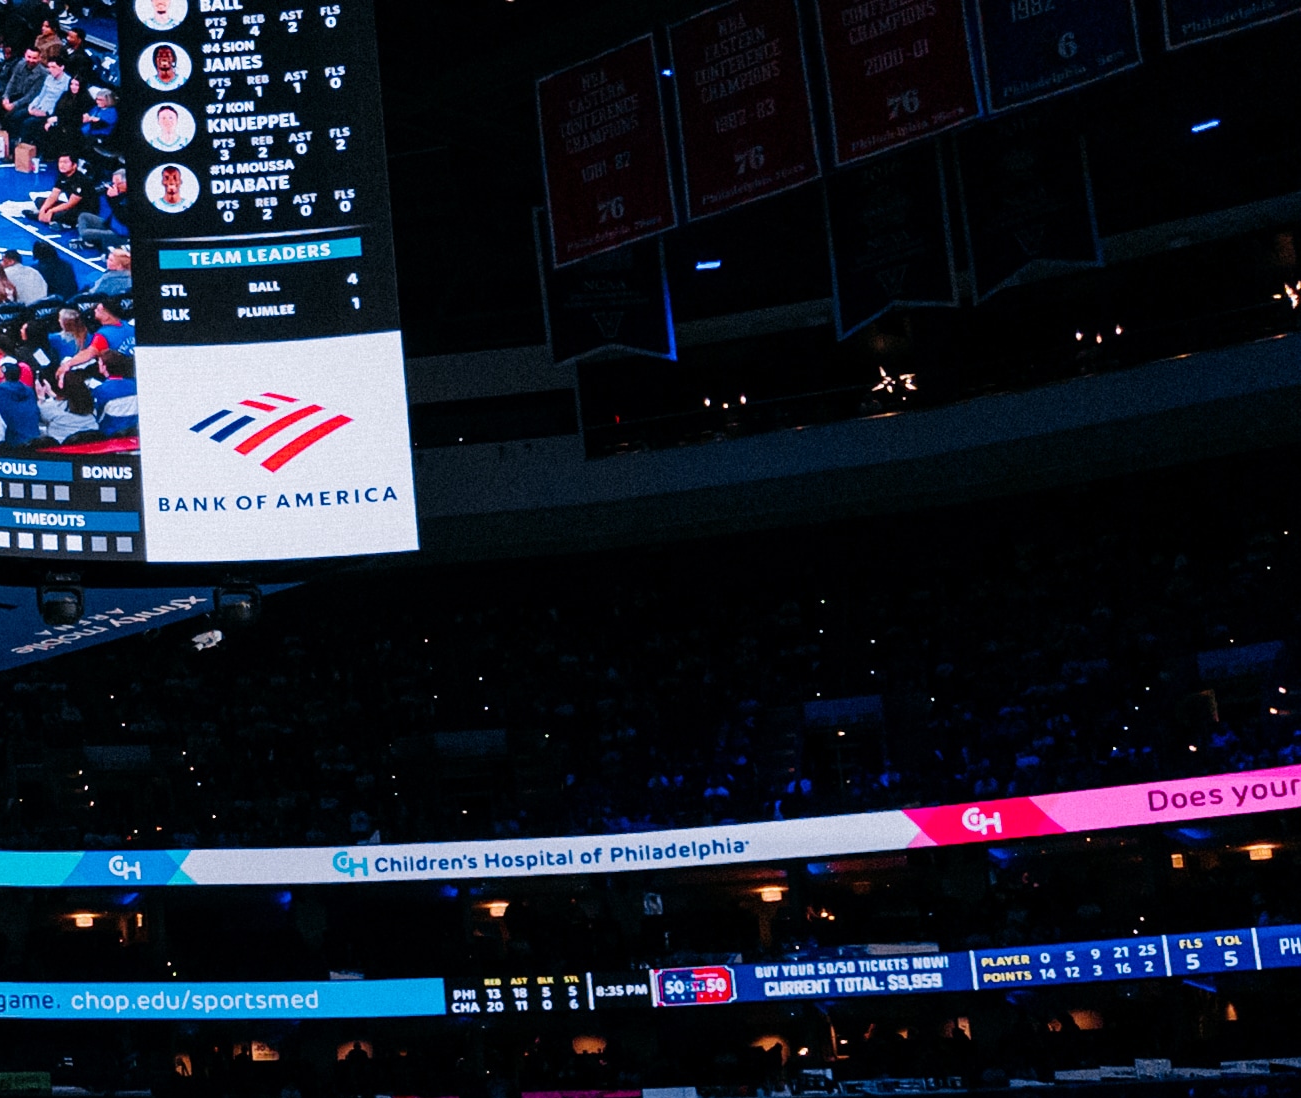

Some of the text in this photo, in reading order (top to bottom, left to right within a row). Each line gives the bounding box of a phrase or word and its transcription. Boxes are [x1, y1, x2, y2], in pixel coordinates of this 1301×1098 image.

[222, 40, 255, 53] SION
[203, 55, 263, 73] JAMES
[226, 101, 255, 114] KON
[887, 88, 920, 119] 76
[207, 113, 300, 134] KNUEPPEL
[236, 159, 295, 175] MOUSSA
[734, 145, 765, 176] 76
[211, 175, 290, 195] DIABATE
[188, 243, 331, 266] TEAM LEADERS
[160, 273, 358, 297] STL BALL 4
[161, 297, 360, 322] BLK PLUMLEE 1
[82, 465, 133, 481] BONUS
[158, 486, 399, 513] BANK OF AMERICA
[13, 511, 86, 528] TIMEOUTS
[1148, 776, 1301, 813] Does your
[374, 835, 745, 876] Children's Hospital of Philadelphia
[1178, 935, 1242, 950] FLS TOL
[981, 944, 1157, 968] PLAYER 0 5 9 21 25
[1186, 951, 1239, 970] 5 5
[755, 955, 949, 979] BUY YOUR 50/50 TICKETS NOW!
[983, 961, 1154, 983] POINTS 14 12 3 16 2
[453, 985, 577, 1000] PHI 13 18 5 5
[595, 984, 648, 997] 8:35 PM
[664, 978, 727, 994] 50 50
[764, 978, 830, 997] CURRENT
[835, 975, 885, 993] TOTAL:
[71, 989, 319, 1014] chop.edu/sportsmed
[451, 999, 579, 1013] CHA 20 11 0 6
